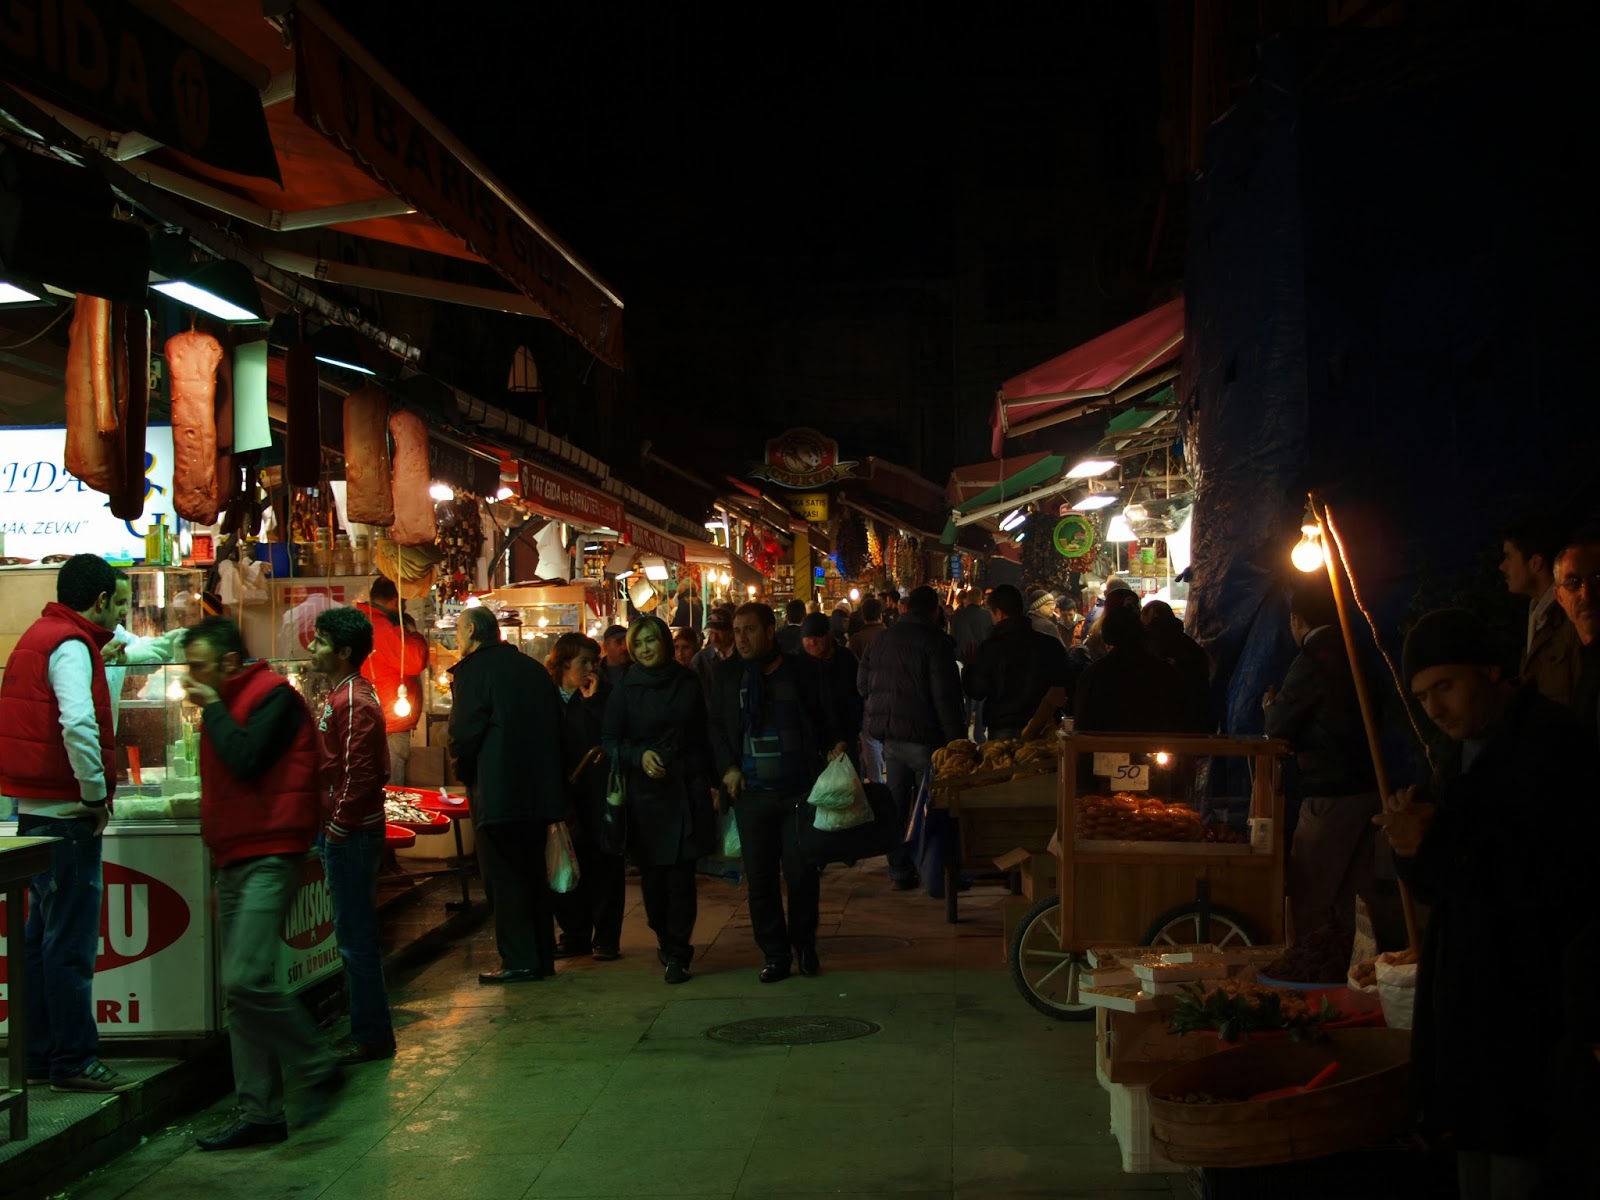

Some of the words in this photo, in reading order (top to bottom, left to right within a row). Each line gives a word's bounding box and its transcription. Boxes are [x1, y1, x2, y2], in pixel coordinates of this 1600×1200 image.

[531, 474, 544, 498] TAT
[544, 479, 561, 503] GIDA
[1113, 765, 1141, 779] 50
